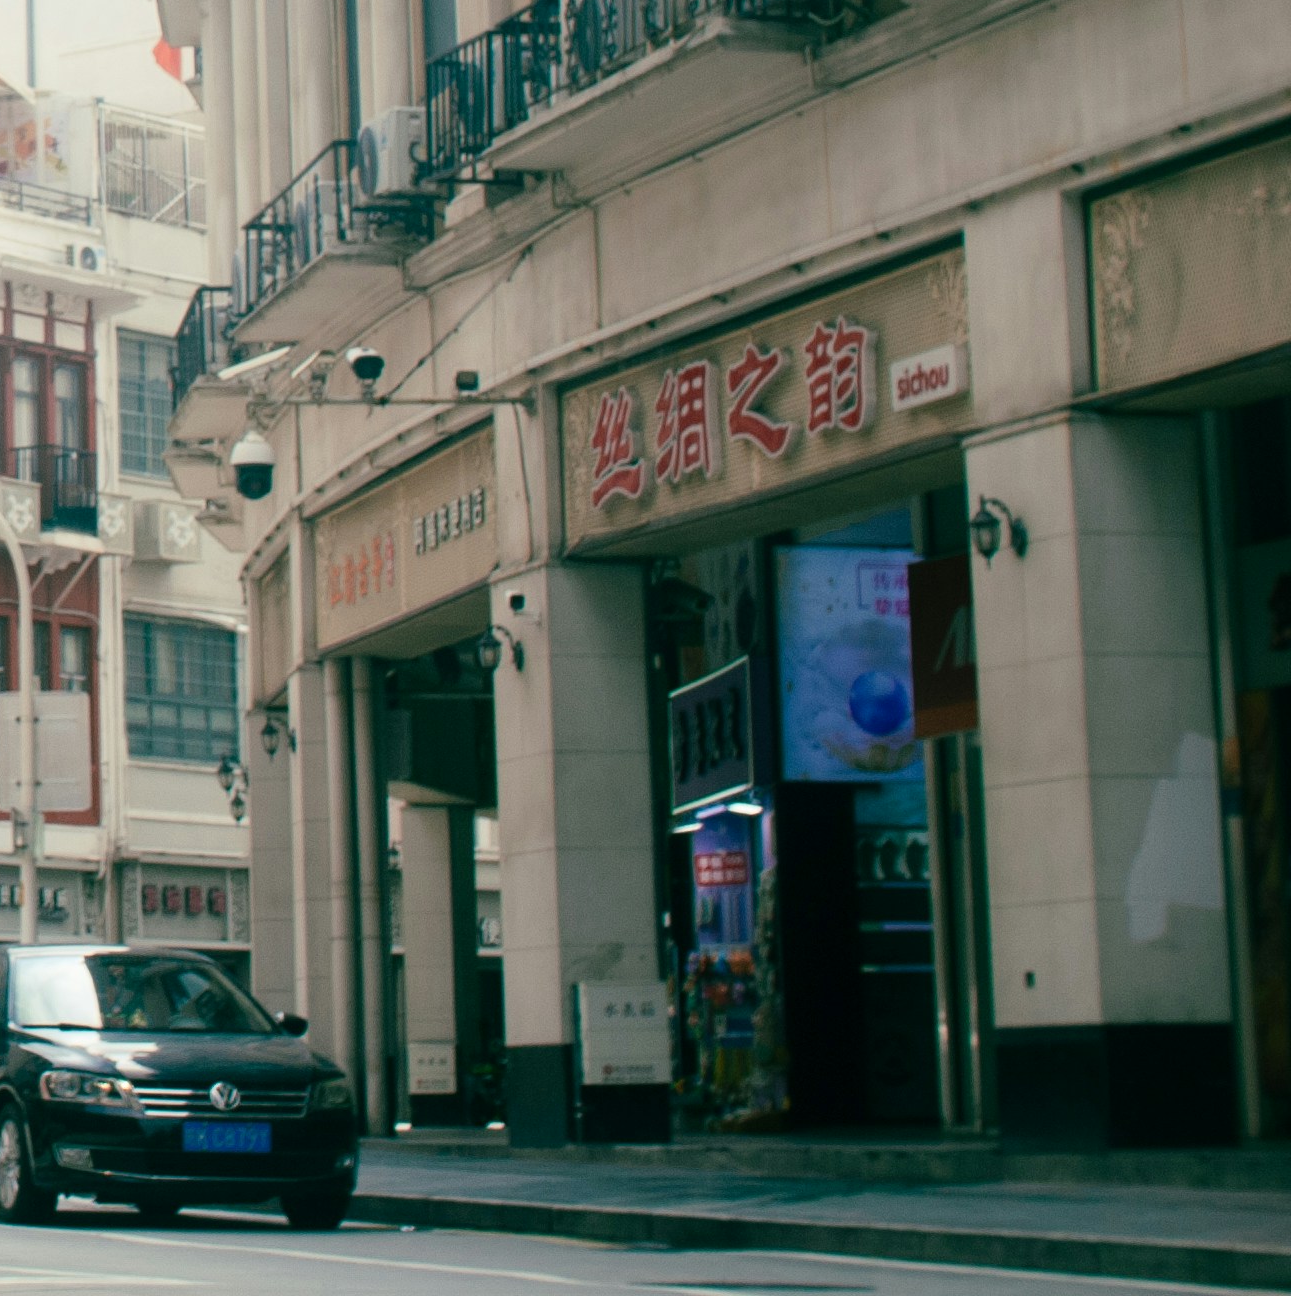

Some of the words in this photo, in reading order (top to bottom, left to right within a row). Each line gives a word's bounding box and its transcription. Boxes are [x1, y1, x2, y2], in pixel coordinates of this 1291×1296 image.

[591, 315, 867, 510] 丝绸之韵
[896, 362, 951, 401] sichou
